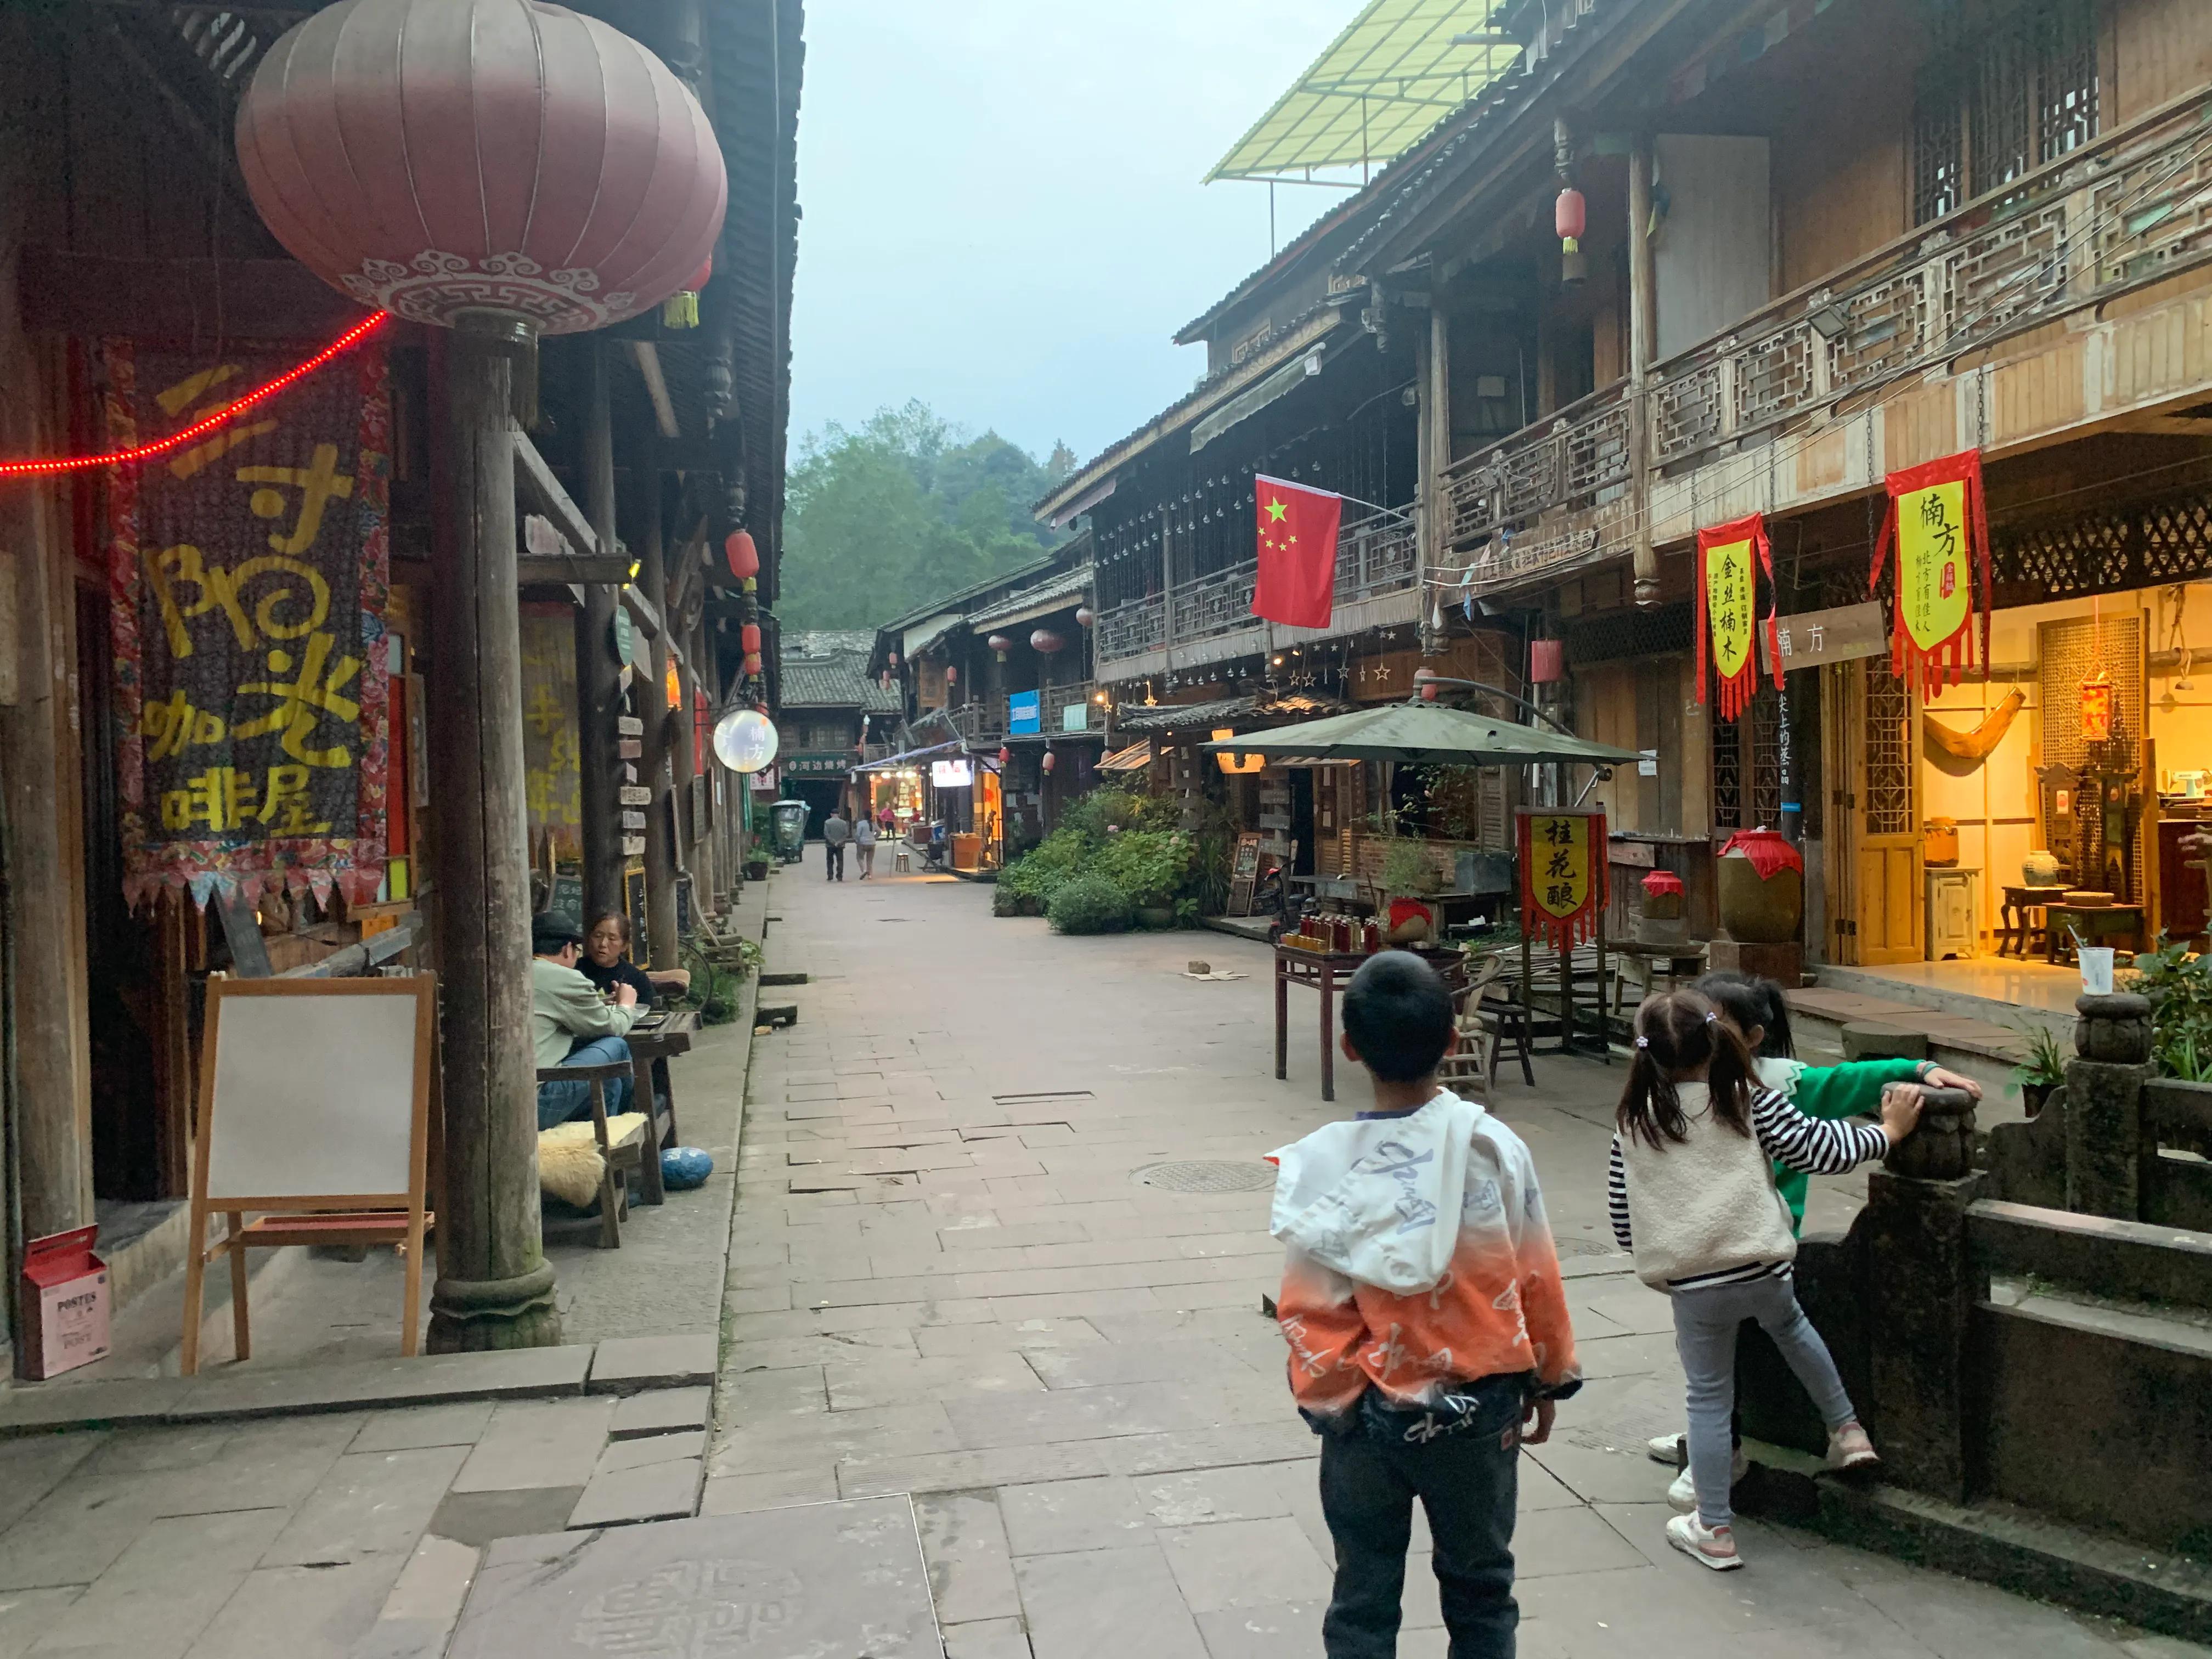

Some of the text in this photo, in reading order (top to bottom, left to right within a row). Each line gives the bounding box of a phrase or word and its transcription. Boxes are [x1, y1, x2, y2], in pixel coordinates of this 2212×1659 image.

[1920, 493, 1959, 557] 楠方
[1719, 554, 1737, 662] 金丝楠木
[749, 726, 765, 760] 楠方
[1779, 679, 1792, 785] 尖上的蒸品
[1545, 820, 1577, 909] 桂花酿
